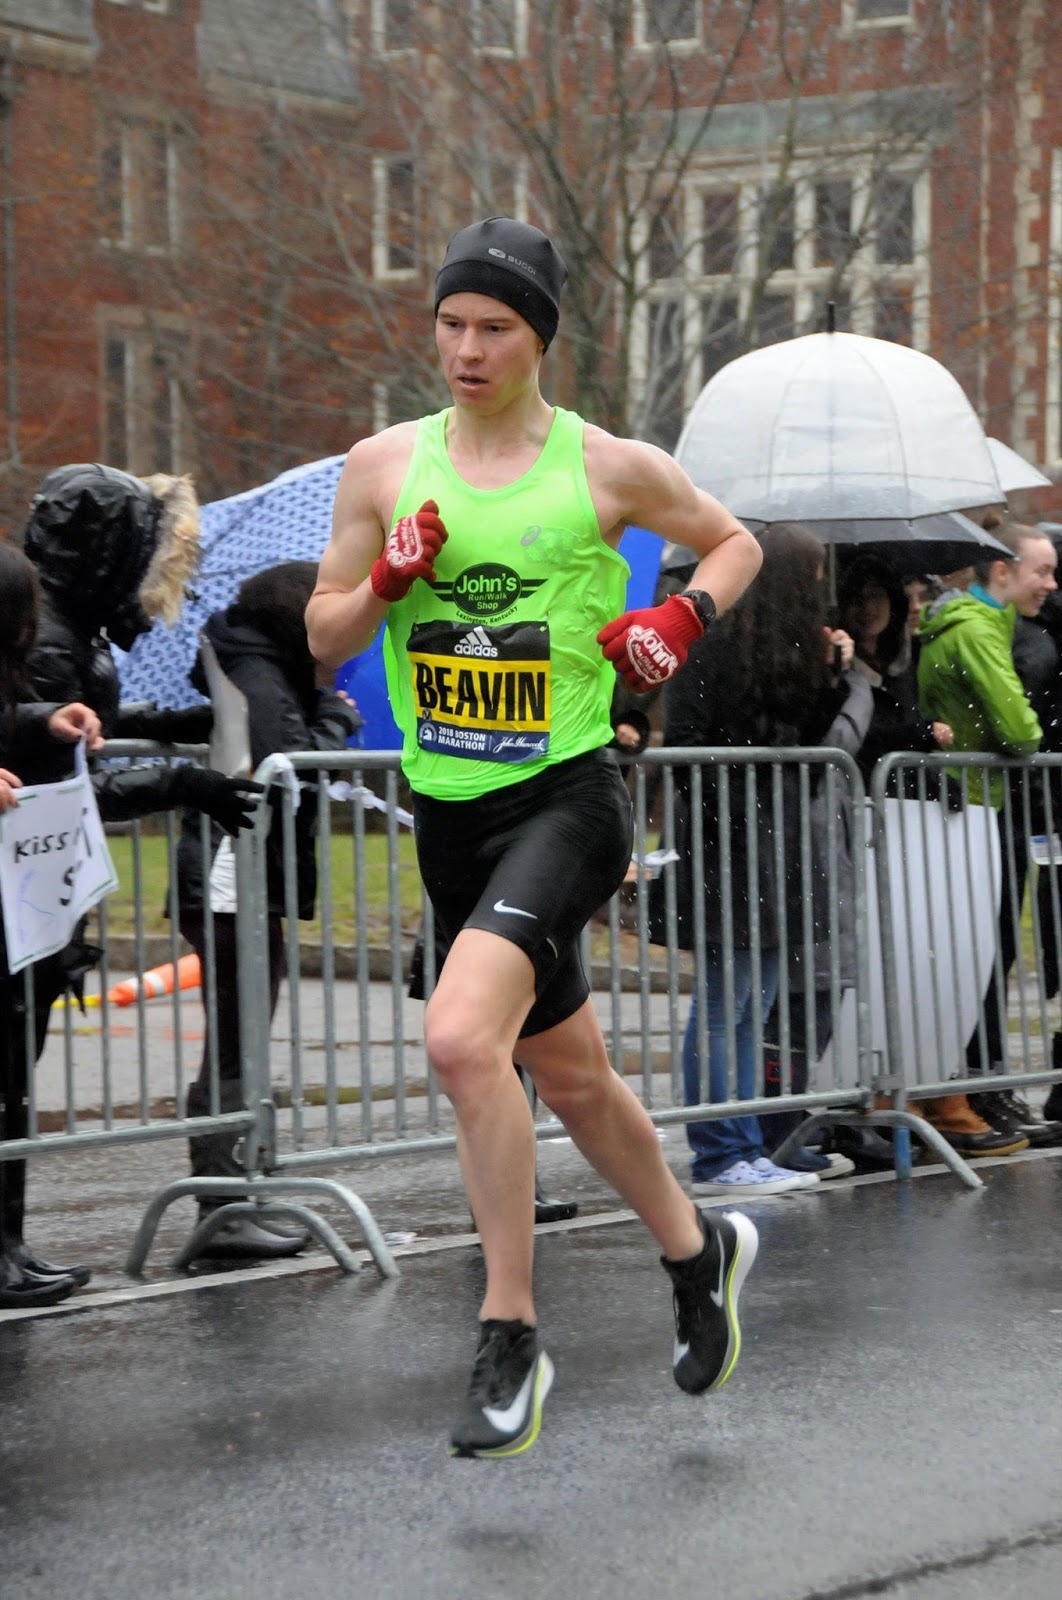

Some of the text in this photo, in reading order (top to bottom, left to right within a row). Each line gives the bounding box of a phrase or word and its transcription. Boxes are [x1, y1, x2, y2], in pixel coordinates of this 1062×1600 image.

[456, 572, 517, 593] John's
[468, 593, 508, 601] Run/Walk
[477, 601, 499, 611] Shop
[490, 606, 518, 623] Kentucky
[454, 643, 498, 658] adidas
[415, 662, 546, 721] BEAVIN
[438, 726, 454, 737] 2018
[455, 730, 486, 742] BOSTON
[438, 735, 486, 751] MARATHON
